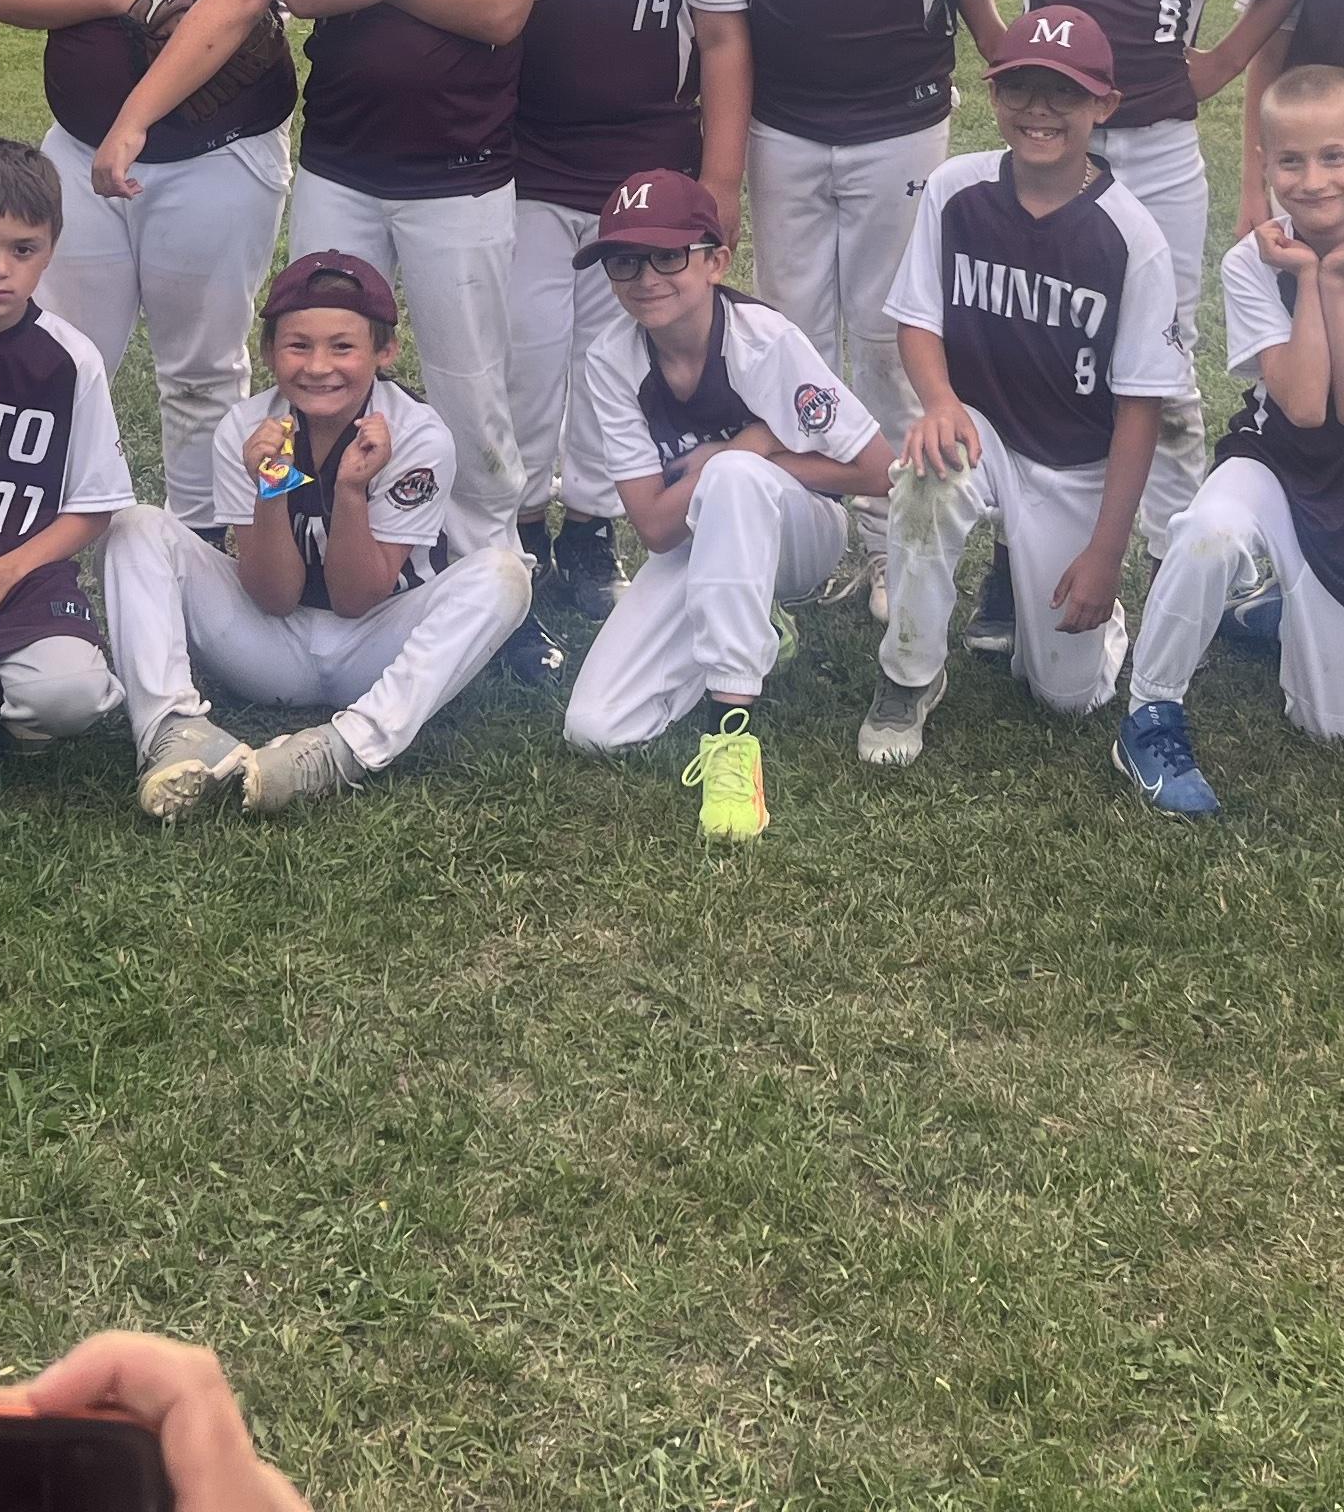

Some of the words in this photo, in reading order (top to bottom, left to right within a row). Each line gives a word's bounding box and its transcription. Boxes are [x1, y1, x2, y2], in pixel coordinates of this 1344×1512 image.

[1029, 17, 1074, 49] M
[612, 183, 654, 216] M
[951, 252, 1107, 340] MINTO
[1073, 345, 1097, 397] 8
